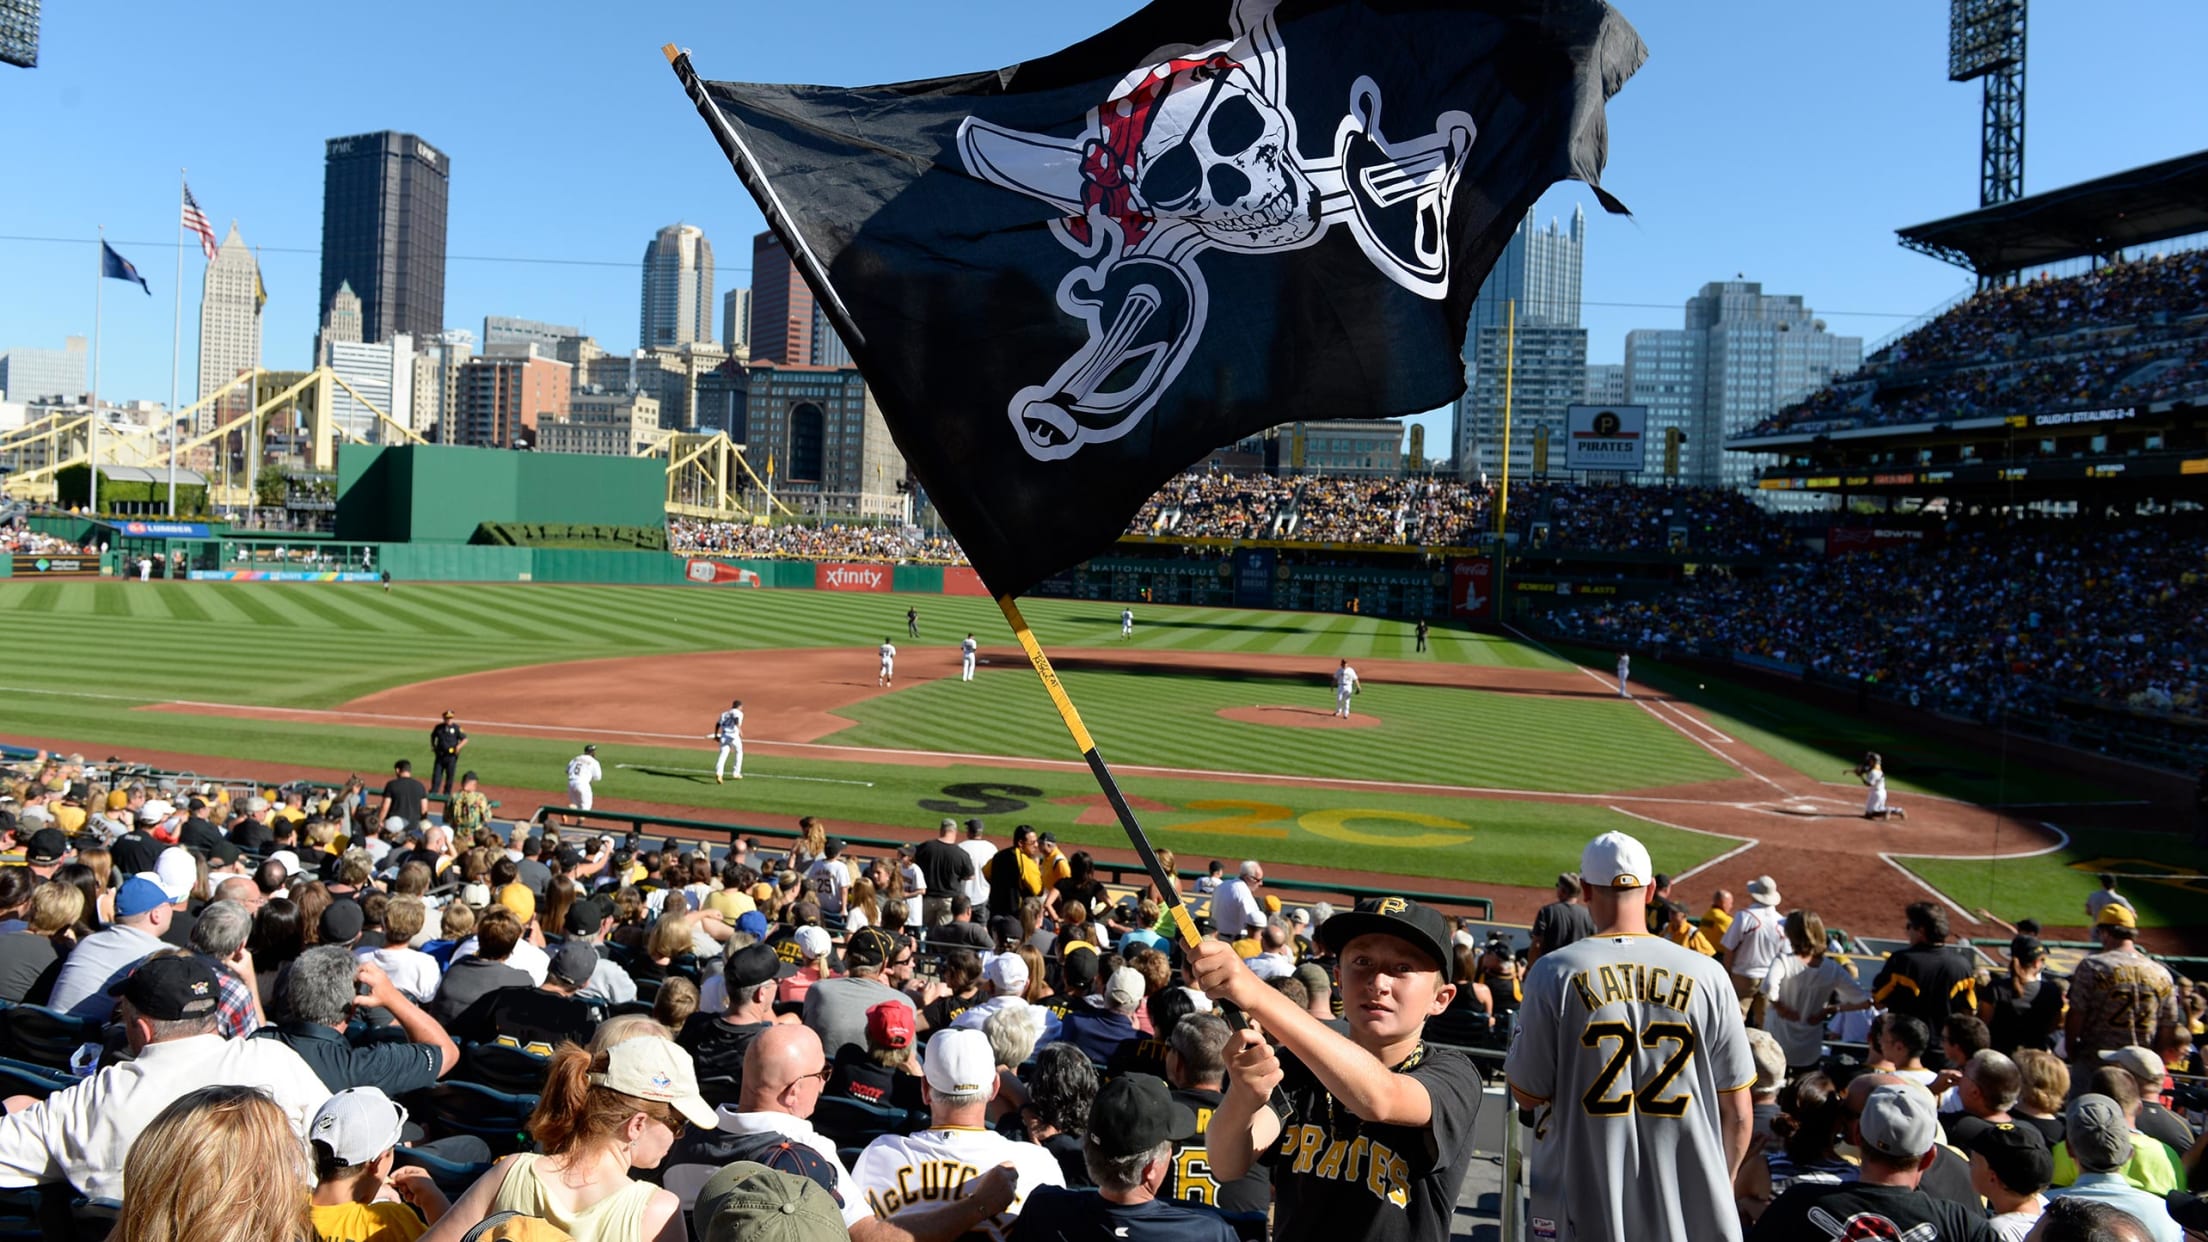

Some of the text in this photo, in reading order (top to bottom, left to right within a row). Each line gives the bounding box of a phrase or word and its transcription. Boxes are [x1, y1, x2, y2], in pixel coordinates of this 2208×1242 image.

[1601, 417, 1613, 433] P
[2034, 412, 2071, 426] CAUGHT
[2071, 408, 2116, 423] STEALING
[1578, 442, 1633, 452] PIRATES
[147, 525, 192, 533] LUMBER
[1873, 529, 1924, 539] BOWTIE
[1091, 563, 1216, 577] NATIONAL LEAGUE
[1454, 562, 1488, 576] Coca-Cola
[826, 568, 882, 589] xfinity
[1293, 572, 1430, 586] AMERICAN LEAGUE
[1572, 963, 1696, 1013] KATICH
[1580, 1020, 1696, 1118] 22
[1279, 1123, 1412, 1210] PRATES
[864, 1158, 980, 1221] McCUTC
